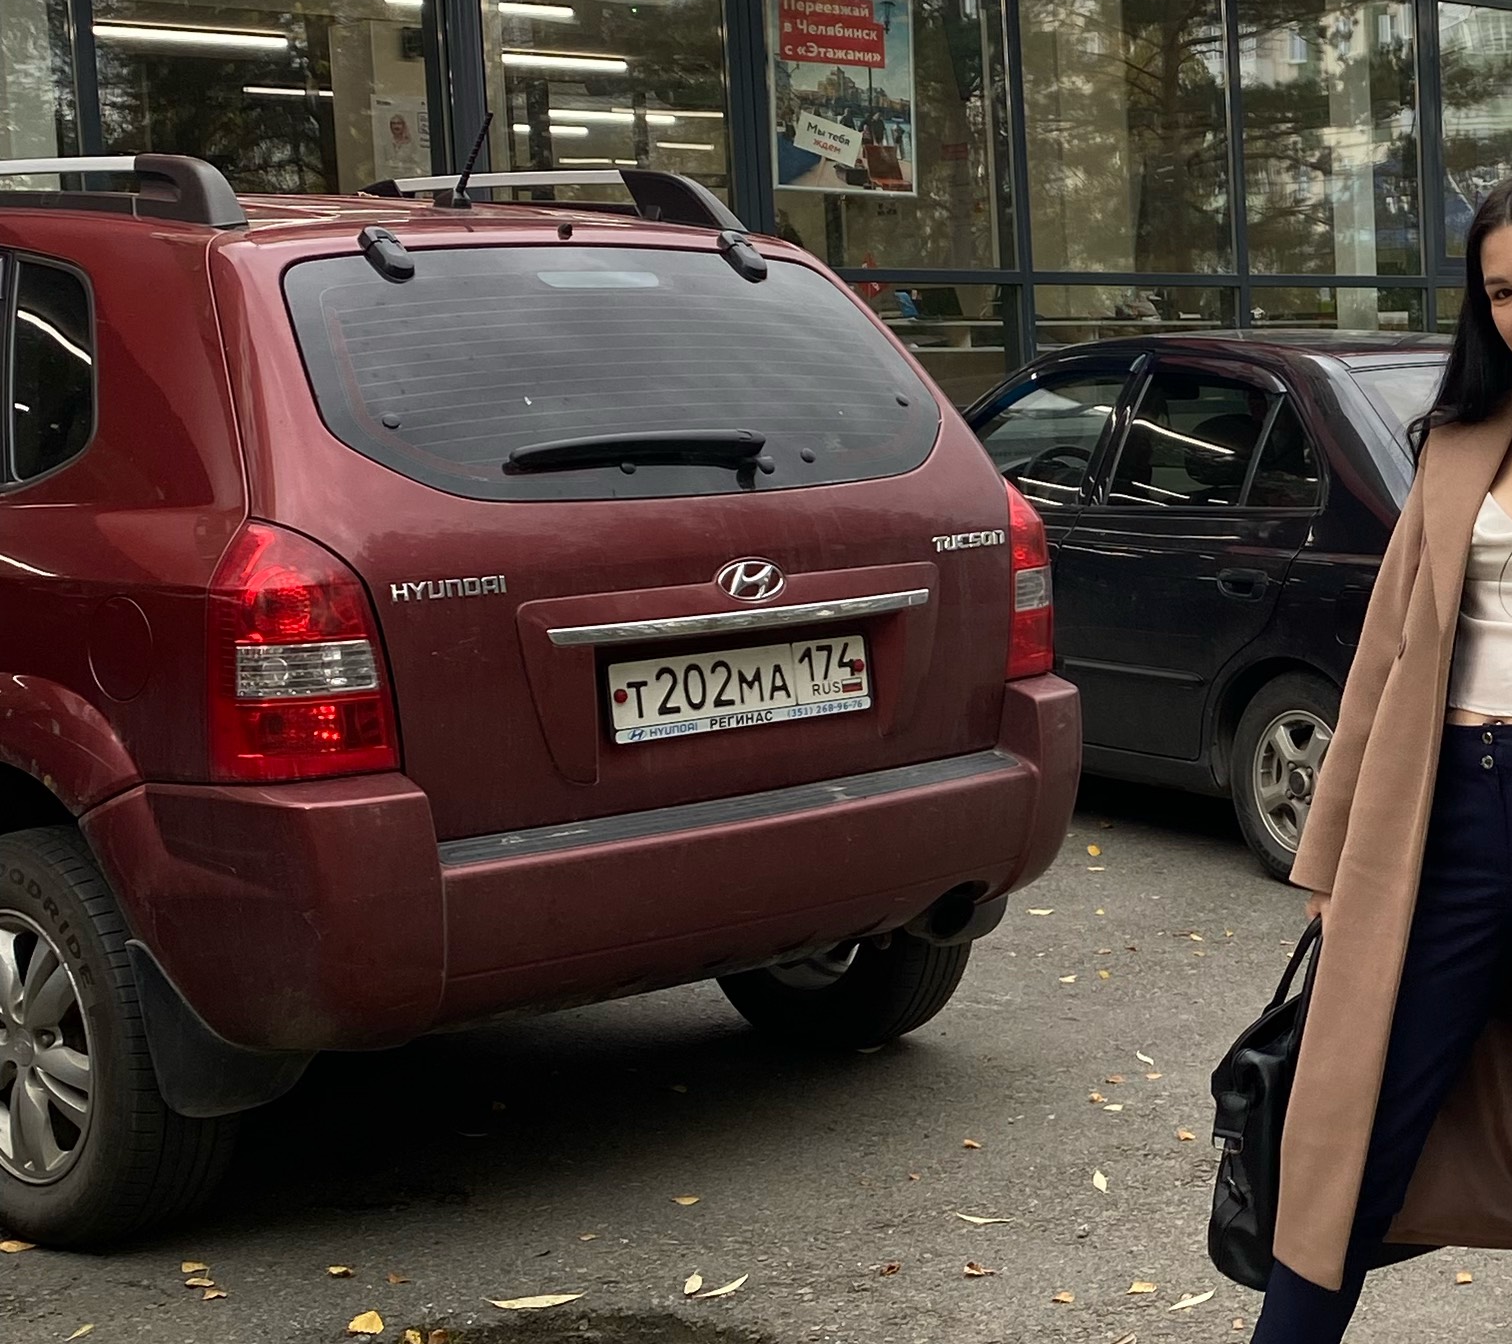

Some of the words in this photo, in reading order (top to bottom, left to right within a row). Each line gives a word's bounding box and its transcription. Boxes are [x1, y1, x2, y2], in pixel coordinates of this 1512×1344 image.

[783, 22, 793, 33] в
[796, 18, 878, 41] Челябинск
[784, 45, 793, 56] с
[797, 42, 881, 62] «Этажами»
[806, 121, 826, 137] Мы
[827, 131, 851, 147] тебя
[389, 574, 507, 602] HYUNDAI
[798, 641, 858, 682] 174
[811, 681, 841, 696] RUS
[649, 722, 698, 738] HYUNDAI
[709, 710, 774, 729] РЕГИНАС
